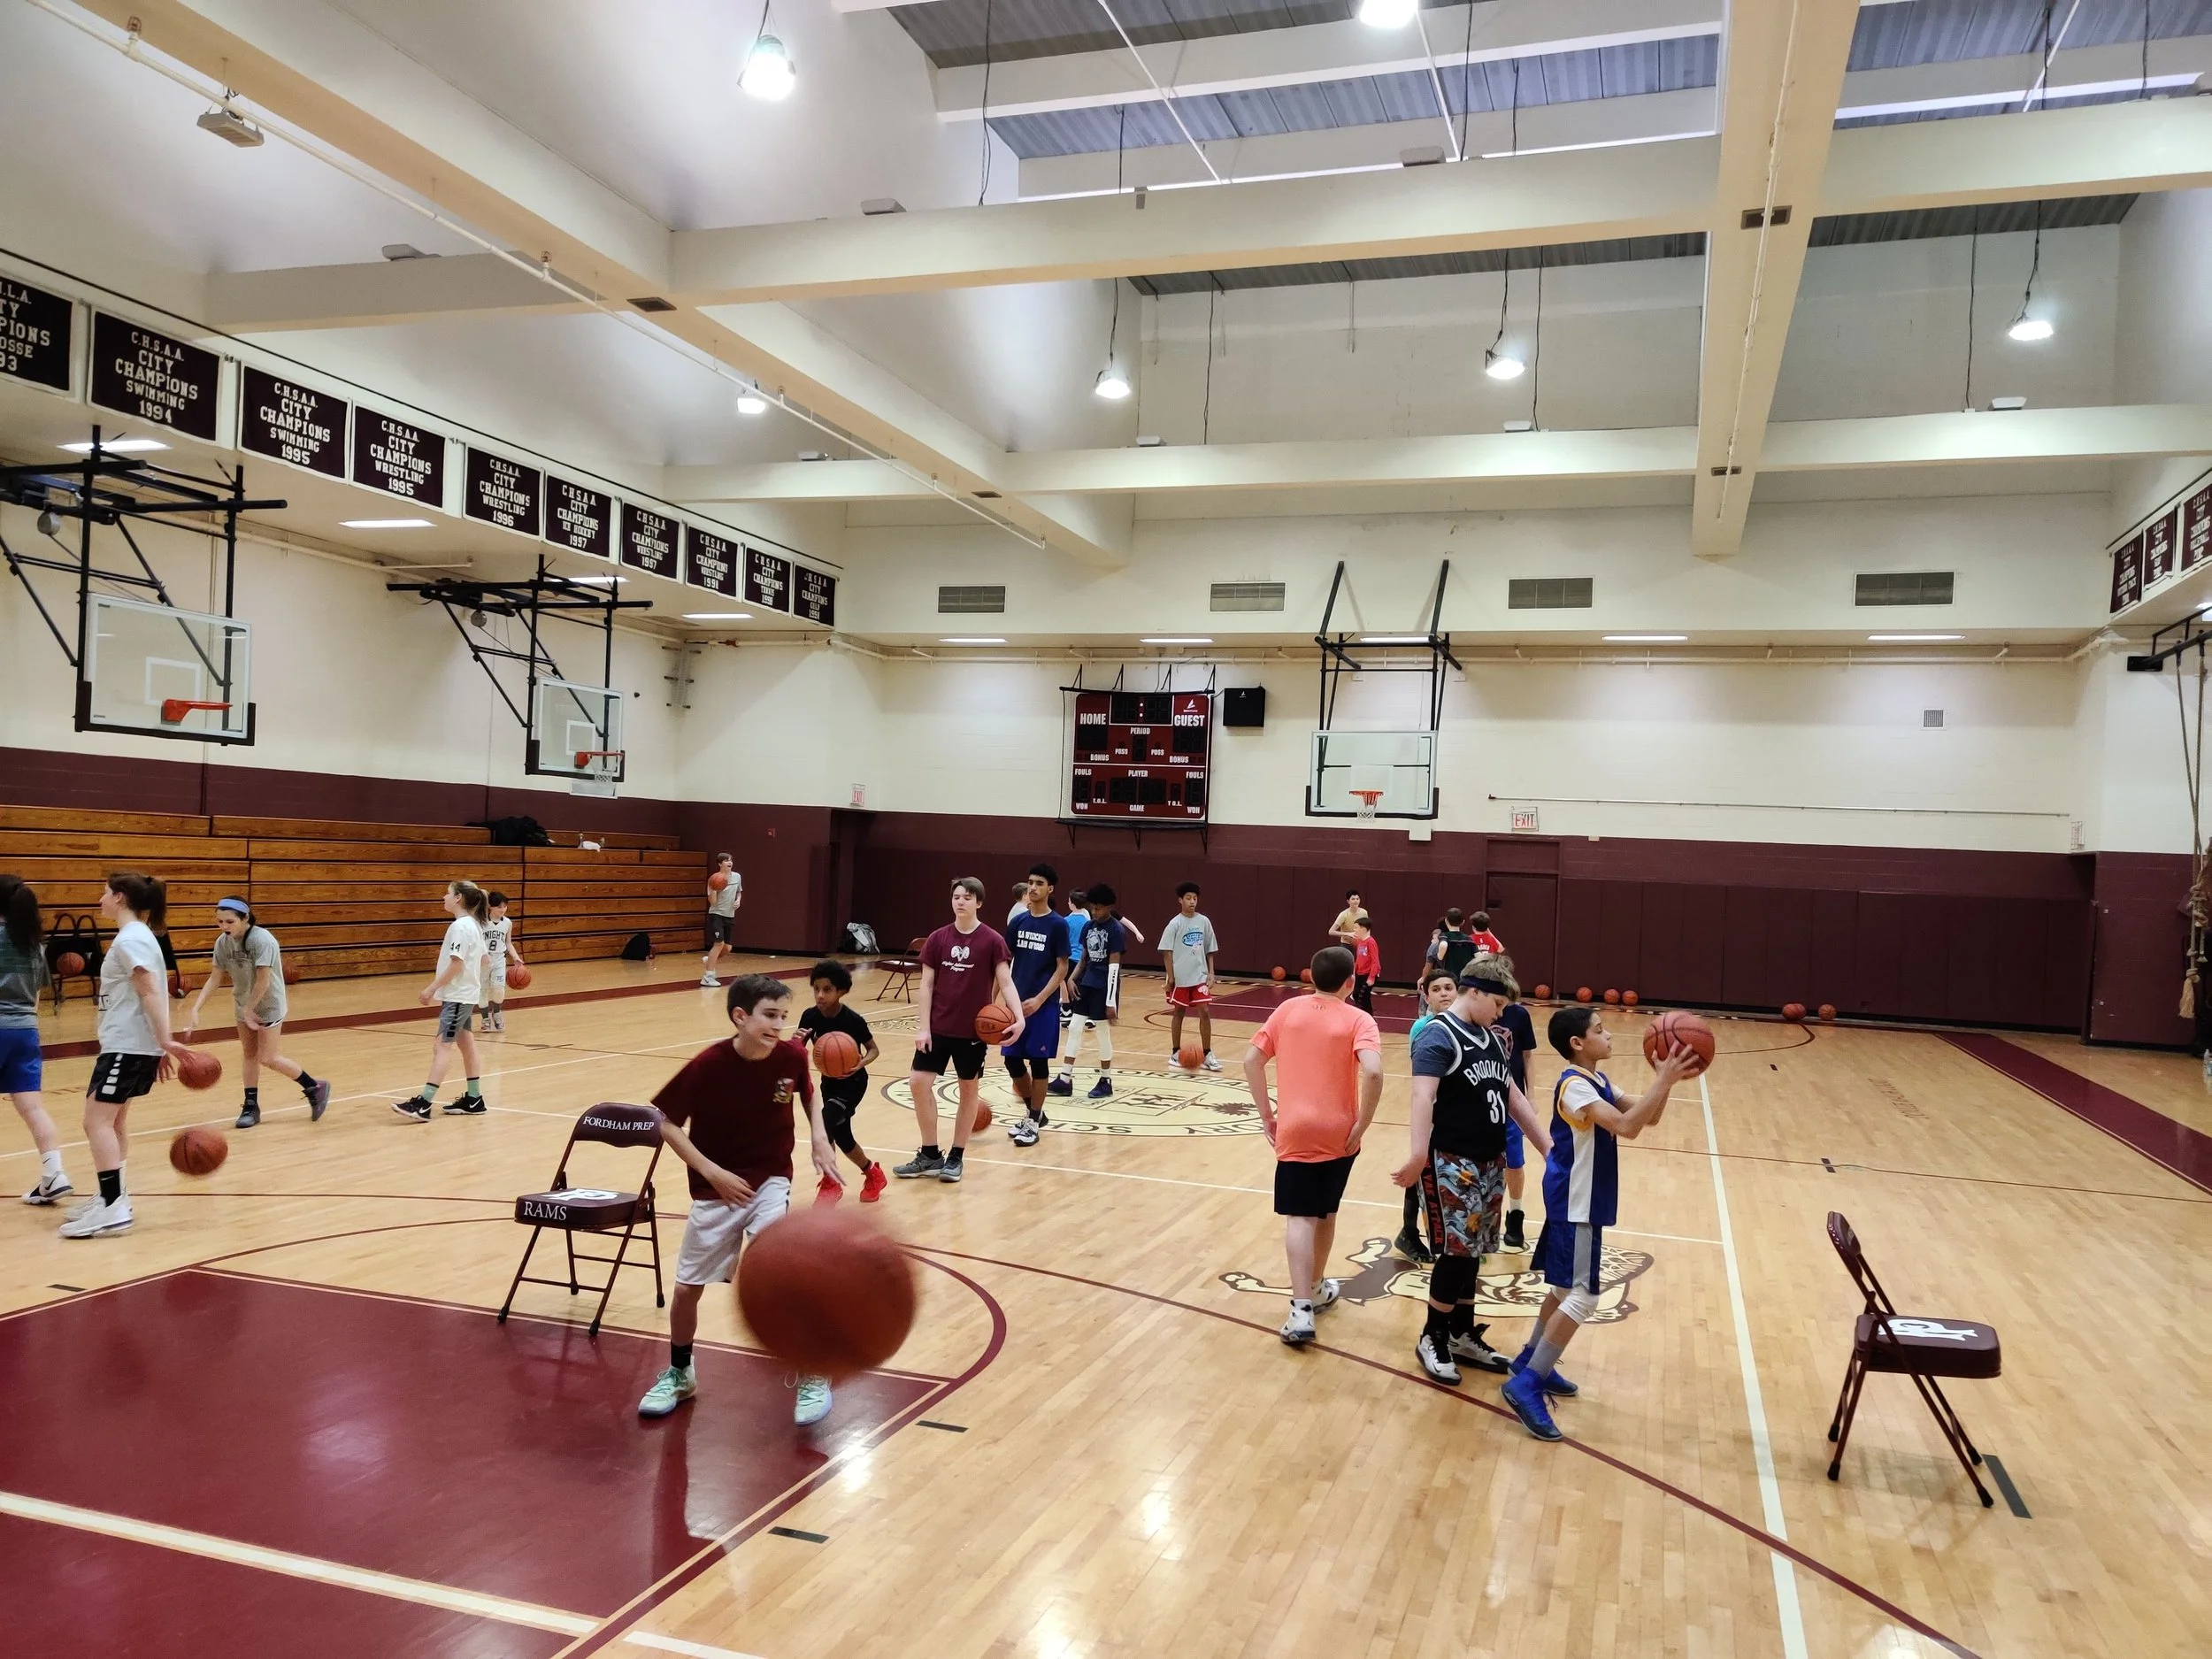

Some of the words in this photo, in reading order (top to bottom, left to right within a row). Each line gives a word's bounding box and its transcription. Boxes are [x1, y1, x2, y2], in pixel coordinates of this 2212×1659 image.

[131, 331, 184, 362] C.H.S.A.A.
[138, 349, 174, 373] CITY
[115, 357, 198, 400] CHAMPIONS
[126, 380, 186, 410] SWIMMING
[274, 382, 319, 408] C.H.S.A.A.
[140, 400, 173, 424] 1994
[281, 398, 312, 420] CITY
[260, 406, 330, 442] CHAMPIONS
[270, 426, 319, 453] SWIMMING
[388, 435, 415, 455] CITY
[281, 443, 311, 465] 1995
[370, 443, 432, 474] CHAMPIONS
[375, 460, 424, 485] WRESTLING
[494, 472, 516, 489] CITY
[388, 477, 414, 496] 1995
[479, 480, 530, 507] CHAMPIONS
[482, 495, 526, 516] WRESTLING
[570, 500, 588, 515] CITY
[493, 510, 514, 527] 1996
[557, 507, 599, 531] CHAMPIONS
[569, 534, 588, 549] 1997
[643, 525, 659, 539] CITY
[632, 532, 669, 554] CHAMPIONS
[695, 554, 728, 573] CHAMPIONS
[705, 547, 720, 560] CITY
[762, 566, 775, 579] CITY
[1079, 713, 1106, 725] HOME
[1174, 714, 1205, 726] GUEST
[1515, 813, 1535, 827] EXIT
[482, 930, 505, 943] NIGHT
[488, 940, 497, 951] 8
[1486, 1089, 1506, 1125] 31
[582, 1116, 631, 1131] FORDHAM
[632, 1121, 655, 1131] PREP
[523, 1201, 567, 1221] RAMS
